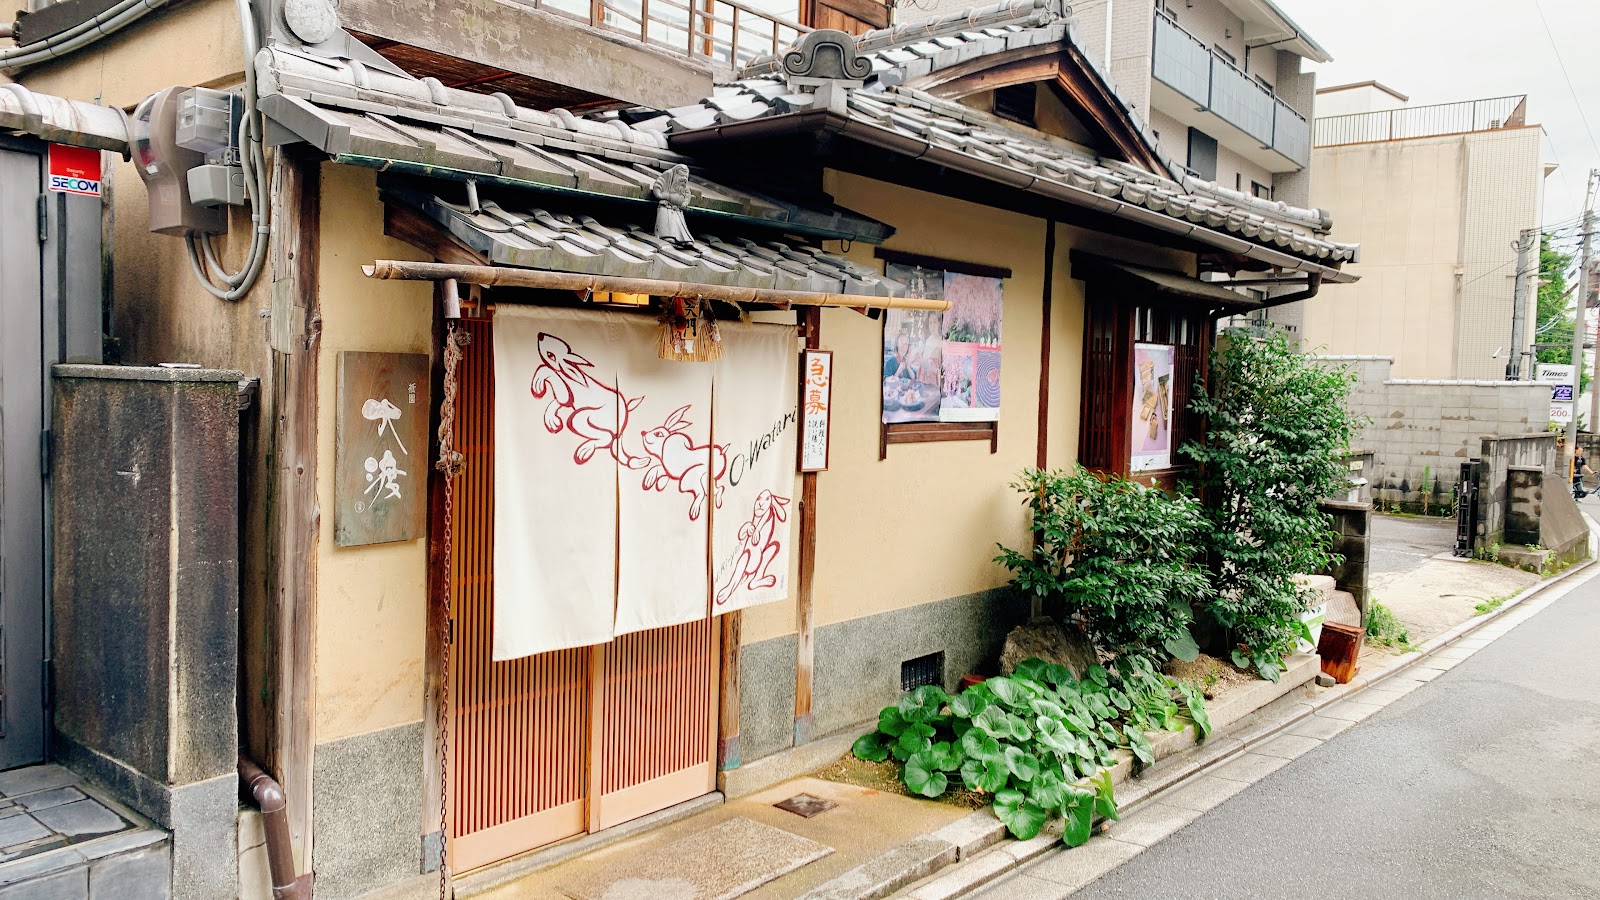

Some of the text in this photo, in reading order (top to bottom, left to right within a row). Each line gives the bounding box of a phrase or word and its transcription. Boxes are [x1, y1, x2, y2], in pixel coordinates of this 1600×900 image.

[52, 177, 98, 192] SECOM
[806, 357, 828, 415] 急募
[1555, 386, 1572, 400] 空
[729, 405, 797, 487] O-Watari
